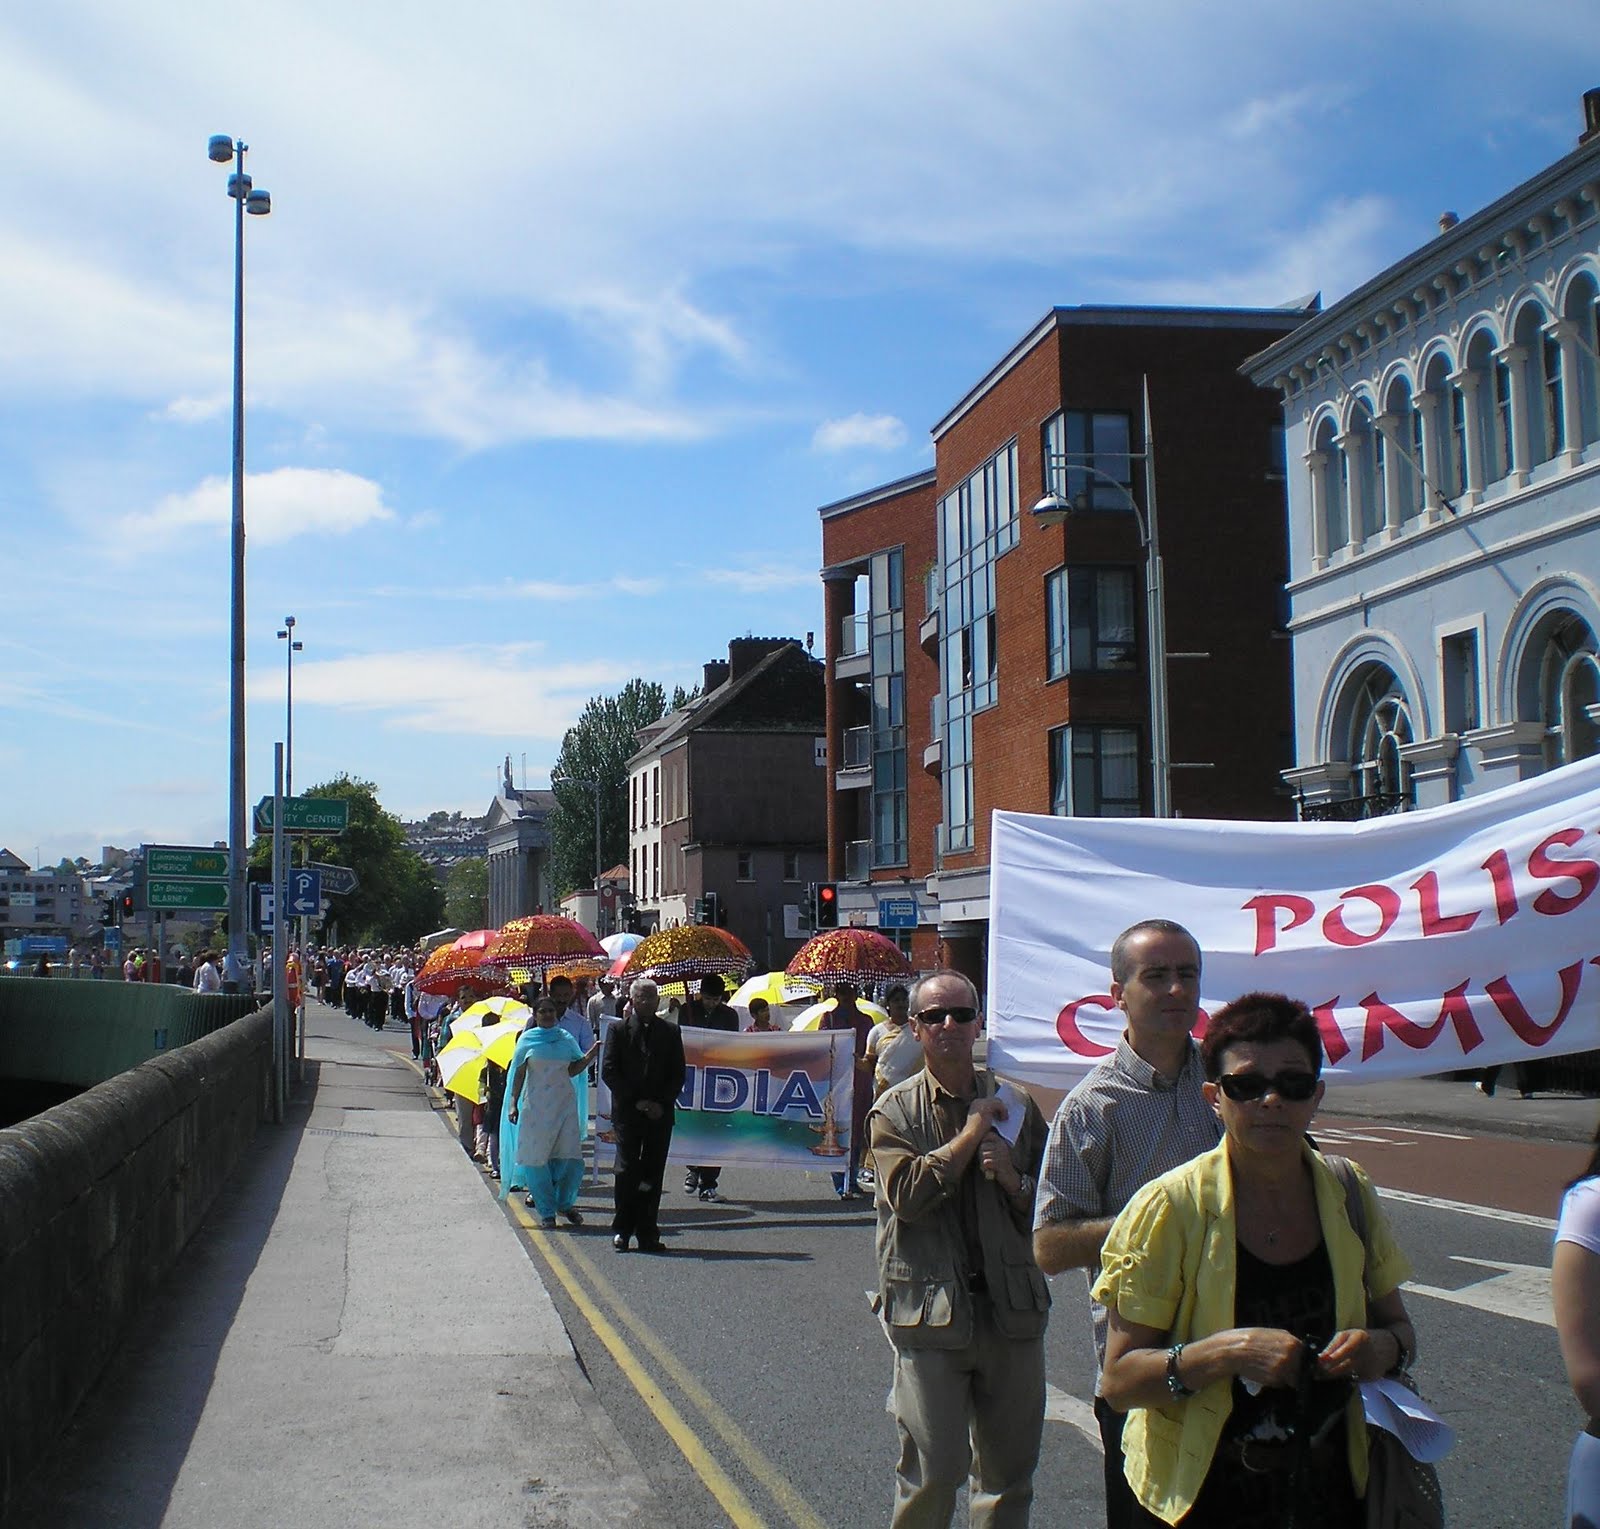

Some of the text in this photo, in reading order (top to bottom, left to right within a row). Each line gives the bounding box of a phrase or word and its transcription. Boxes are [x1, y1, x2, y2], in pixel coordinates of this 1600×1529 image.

[283, 813, 343, 824] ITY CENTRE
[152, 863, 188, 871] LIMERICK
[195, 858, 217, 870] N20
[299, 879, 310, 894] P
[1241, 827, 1600, 957] POLIS
[152, 895, 187, 904] BLARNEY
[674, 1064, 825, 1118] NDIA
